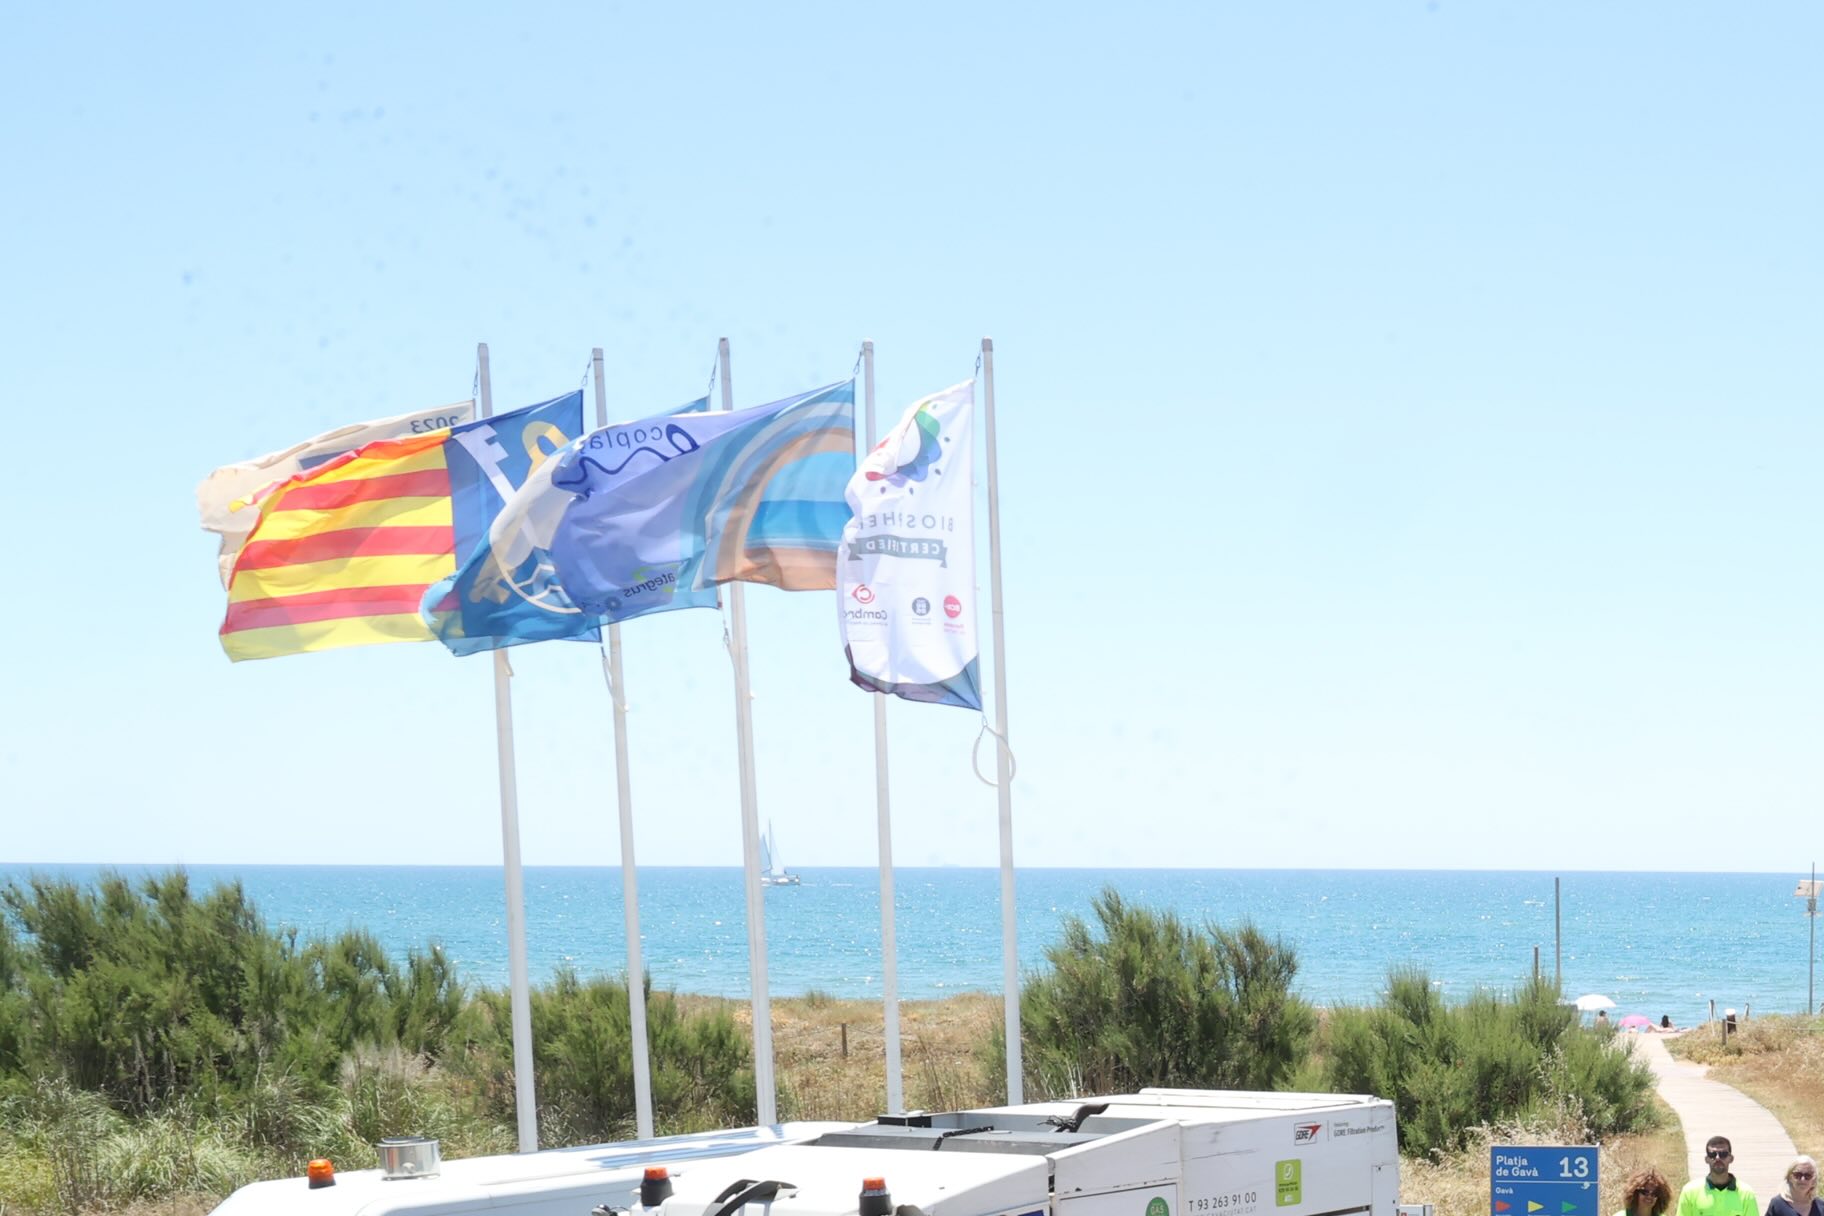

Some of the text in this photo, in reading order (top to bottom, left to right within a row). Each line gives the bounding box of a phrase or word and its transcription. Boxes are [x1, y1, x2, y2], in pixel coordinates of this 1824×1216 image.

[1496, 1155, 1528, 1167] Platja
[1560, 1156, 1589, 1177] 13
[1496, 1167, 1539, 1176] de Gavà
[1189, 1192, 1257, 1213] T 93 263 91 00
